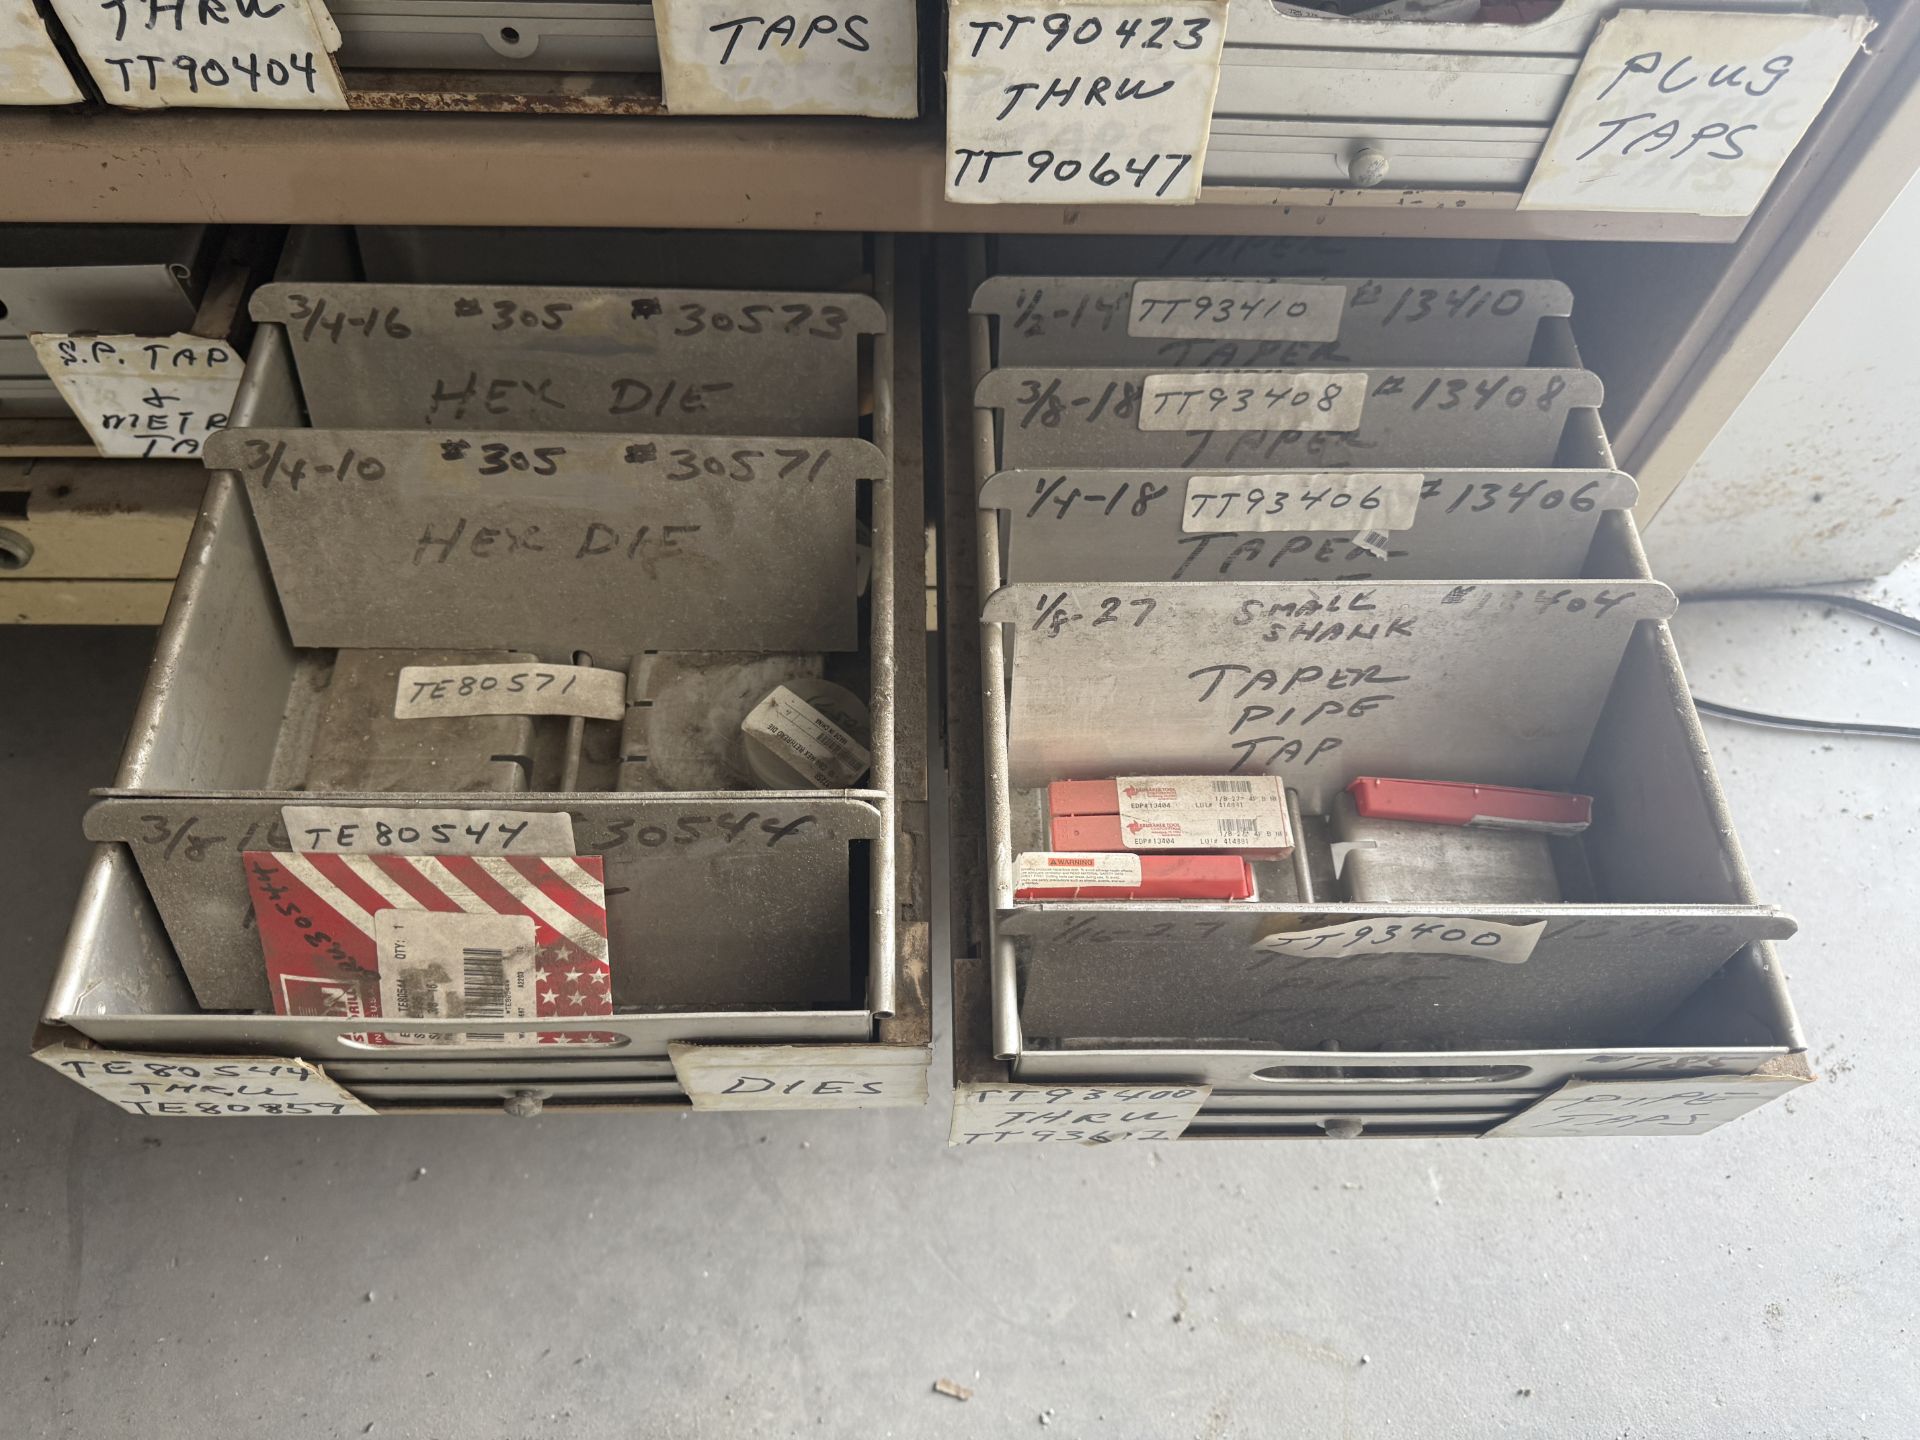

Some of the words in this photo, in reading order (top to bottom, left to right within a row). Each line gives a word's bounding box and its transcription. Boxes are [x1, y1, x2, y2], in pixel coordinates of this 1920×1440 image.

[710, 15, 870, 64] TAPS
[969, 13, 1211, 57] TT90423
[105, 52, 316, 93] TT90404
[1576, 113, 1757, 160] TAPS
[955, 149, 1192, 196] TT90647
[288, 294, 411, 343] 3/4-16
[1139, 296, 1308, 323] TT93410
[143, 344, 229, 370] TAP
[425, 371, 566, 424] HEX
[608, 377, 734, 417] DIE
[1017, 378, 1142, 429] 3/8-18
[1154, 383, 1342, 415] TT93408
[245, 439, 386, 491] 3/4-10
[1027, 475, 1168, 519] 1/4-18
[1191, 485, 1382, 518] TT93406
[412, 517, 544, 566] HEX
[576, 522, 701, 560] DIE
[1262, 616, 1418, 643] SHANK
[410, 672, 576, 703] TE80571
[1188, 664, 1410, 702] TAPER
[1229, 695, 1395, 735] PIPE
[1229, 736, 1343, 772] TAP
[304, 821, 528, 849] TE80544
[1267, 922, 1502, 950] TT93400
[61, 1060, 312, 1081] TE80544
[721, 1076, 884, 1095] DIES
[120, 1100, 345, 1115] TE80859
[975, 1088, 1198, 1104] TT93400
[1530, 1113, 1710, 1128] TAPS
